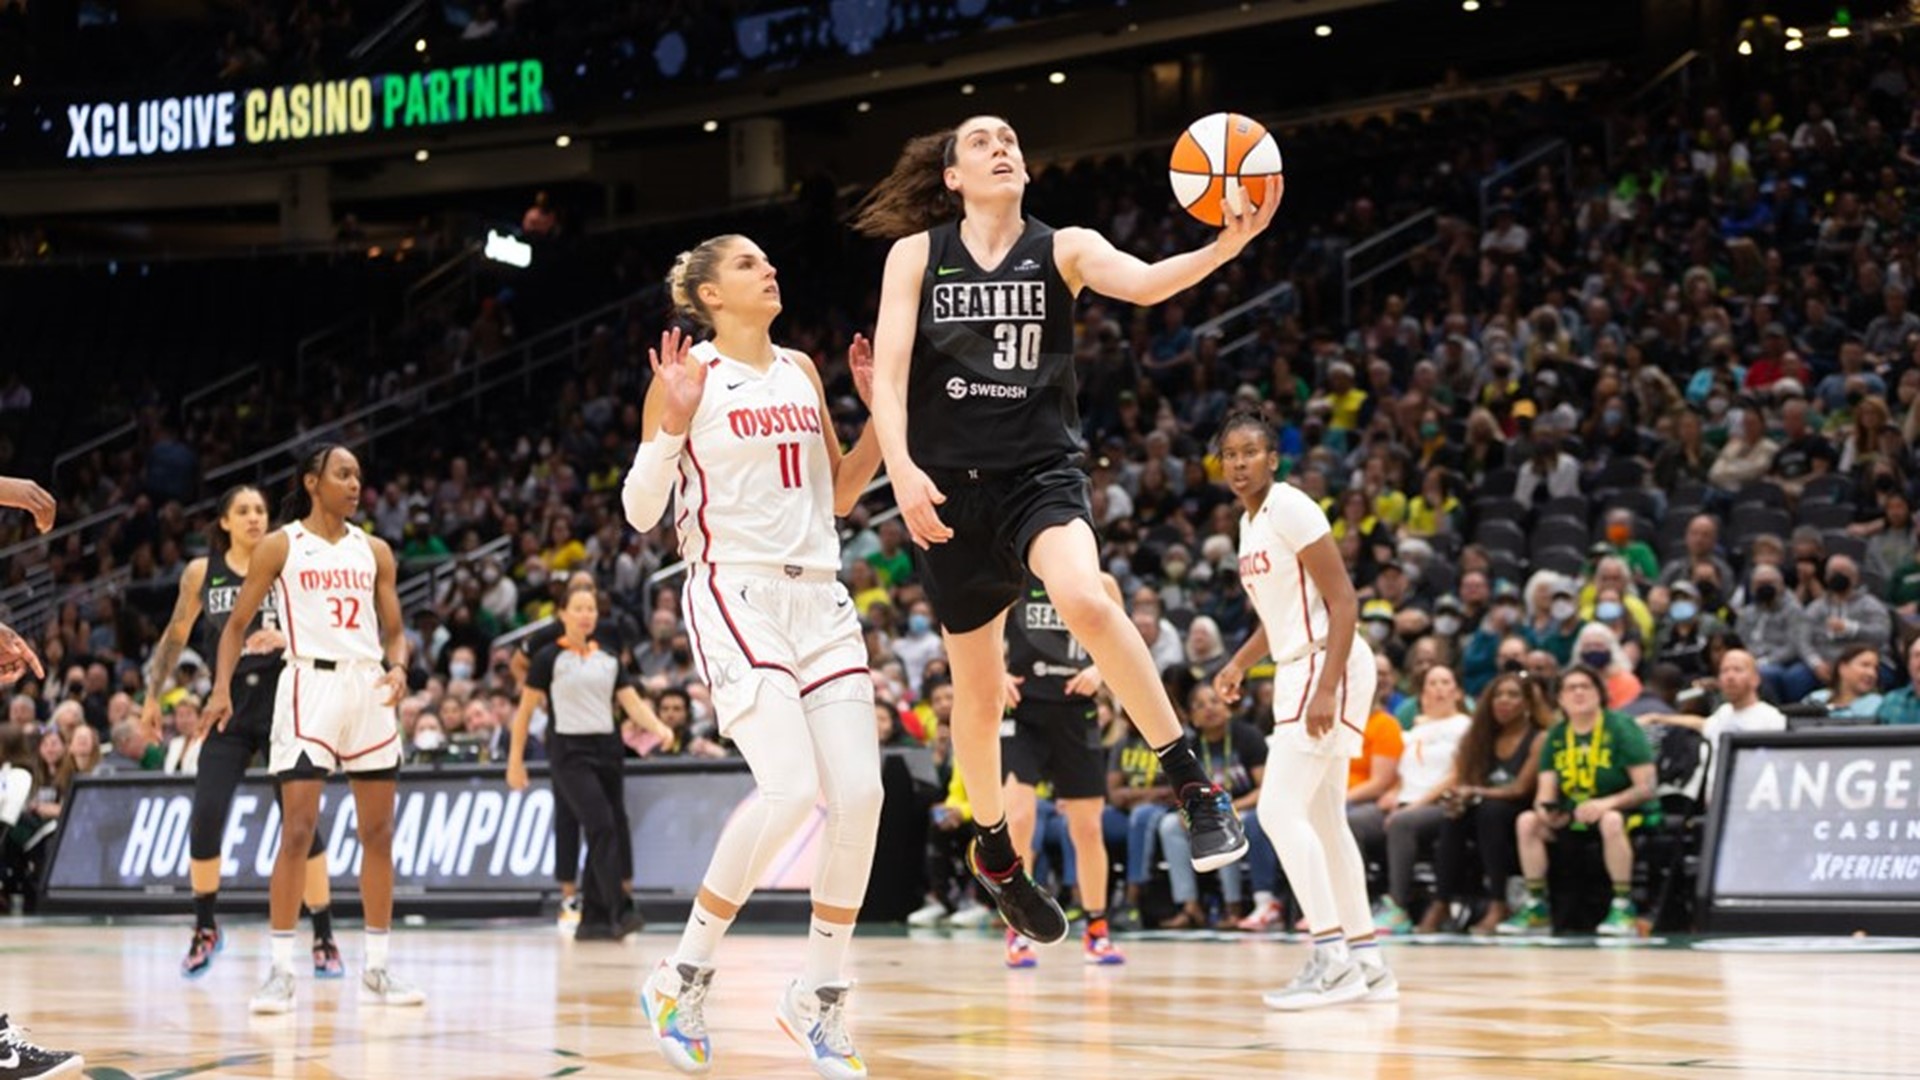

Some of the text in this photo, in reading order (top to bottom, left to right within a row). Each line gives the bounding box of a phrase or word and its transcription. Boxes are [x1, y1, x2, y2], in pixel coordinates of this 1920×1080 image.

[67, 59, 543, 157] XCLUSIVE CASINO PARTNER
[934, 284, 1044, 319] SEATTLE
[993, 323, 1043, 370] 30
[970, 383, 1028, 399] SWEDISH
[777, 442, 802, 488] 11
[327, 597, 361, 629] 32
[1746, 759, 1920, 811] ANGE
[119, 796, 258, 877] HOE
